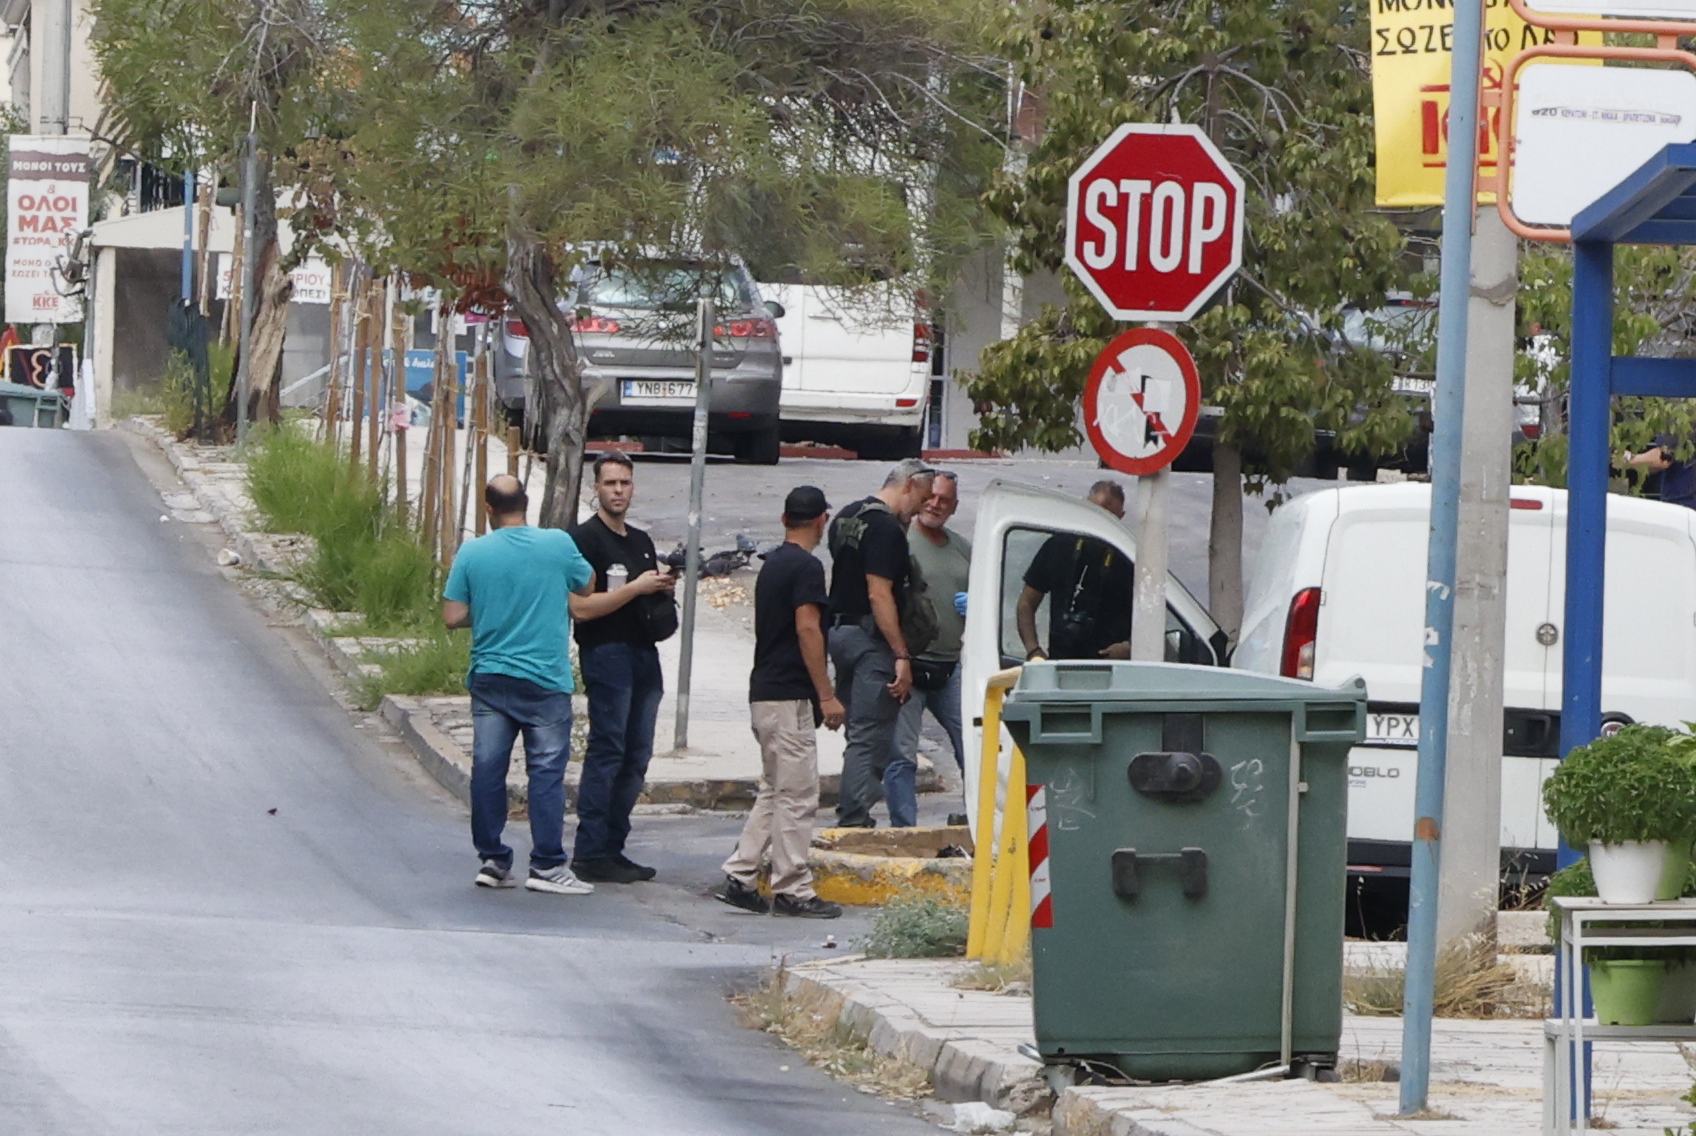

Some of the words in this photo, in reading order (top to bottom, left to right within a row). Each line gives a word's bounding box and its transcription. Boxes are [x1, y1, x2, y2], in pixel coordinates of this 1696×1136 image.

[1376, 24, 1453, 56] ΣΩΖΕ
[12, 160, 52, 171] ΜΟΝΟΙ
[54, 162, 86, 173] ΤΟΥΣ
[18, 194, 77, 213] ΟΛΟΙ
[18, 214, 77, 233] ΜΑΣ
[1083, 178, 1228, 274] STOP
[33, 296, 59, 308] ΚΚΕ
[1373, 716, 1415, 738] YPX
[1347, 766, 1400, 778] OBLO
